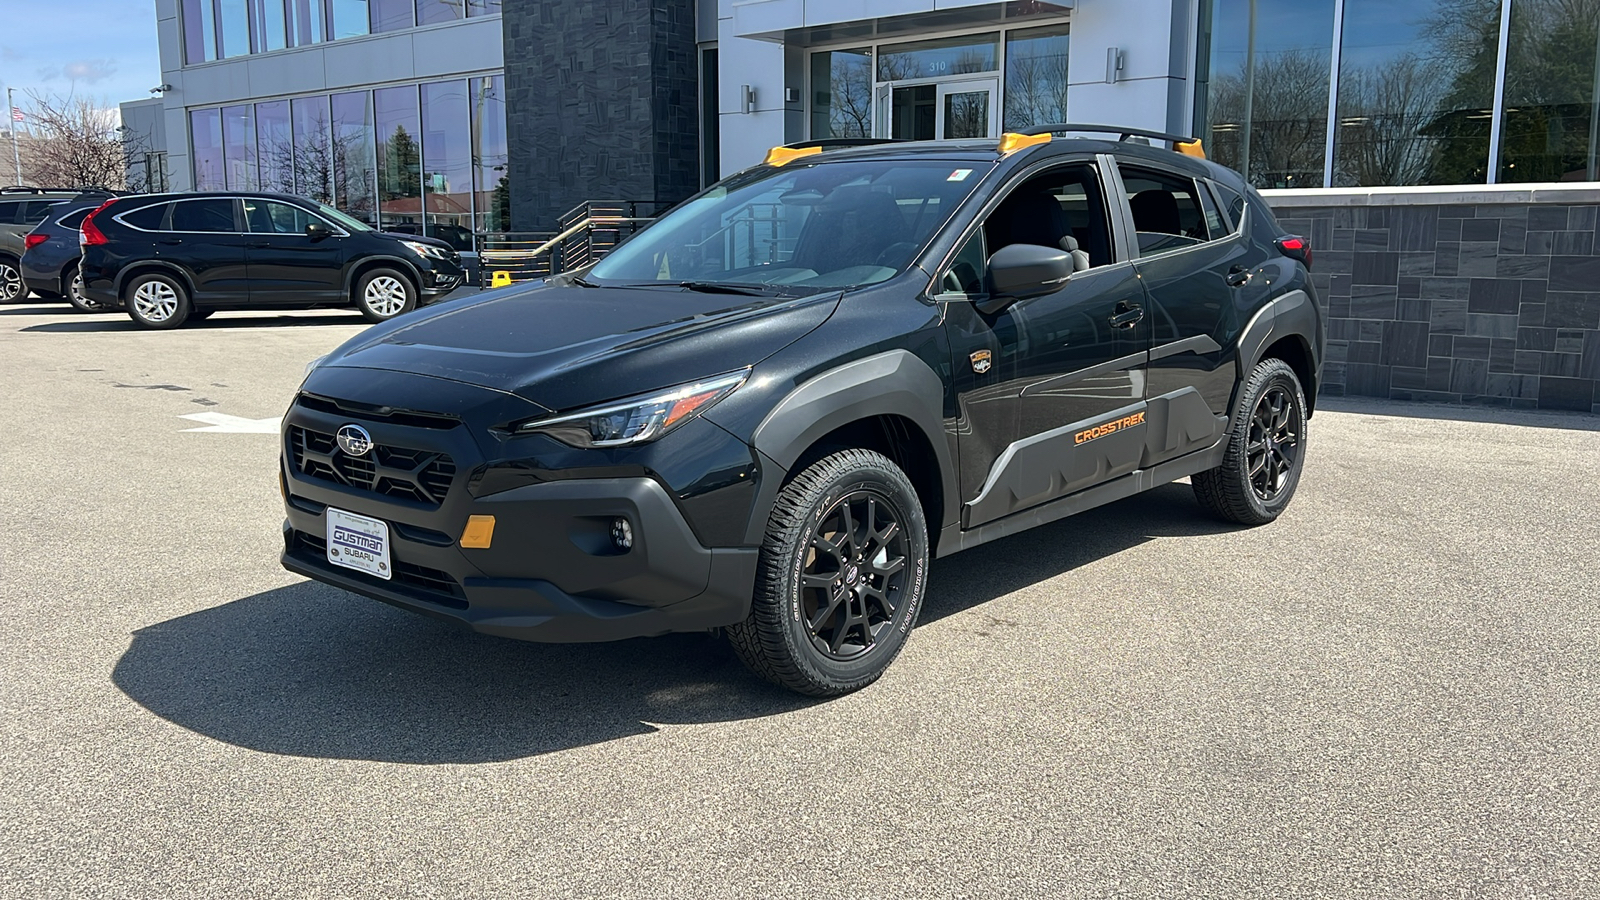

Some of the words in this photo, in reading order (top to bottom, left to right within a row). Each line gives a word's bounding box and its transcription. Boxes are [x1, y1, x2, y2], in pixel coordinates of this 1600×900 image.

[929, 61, 946, 72] 310
[1074, 411, 1146, 444] CROSSTREK
[344, 547, 374, 562] SUBARU
[900, 557, 923, 635] YOKOHAMA
